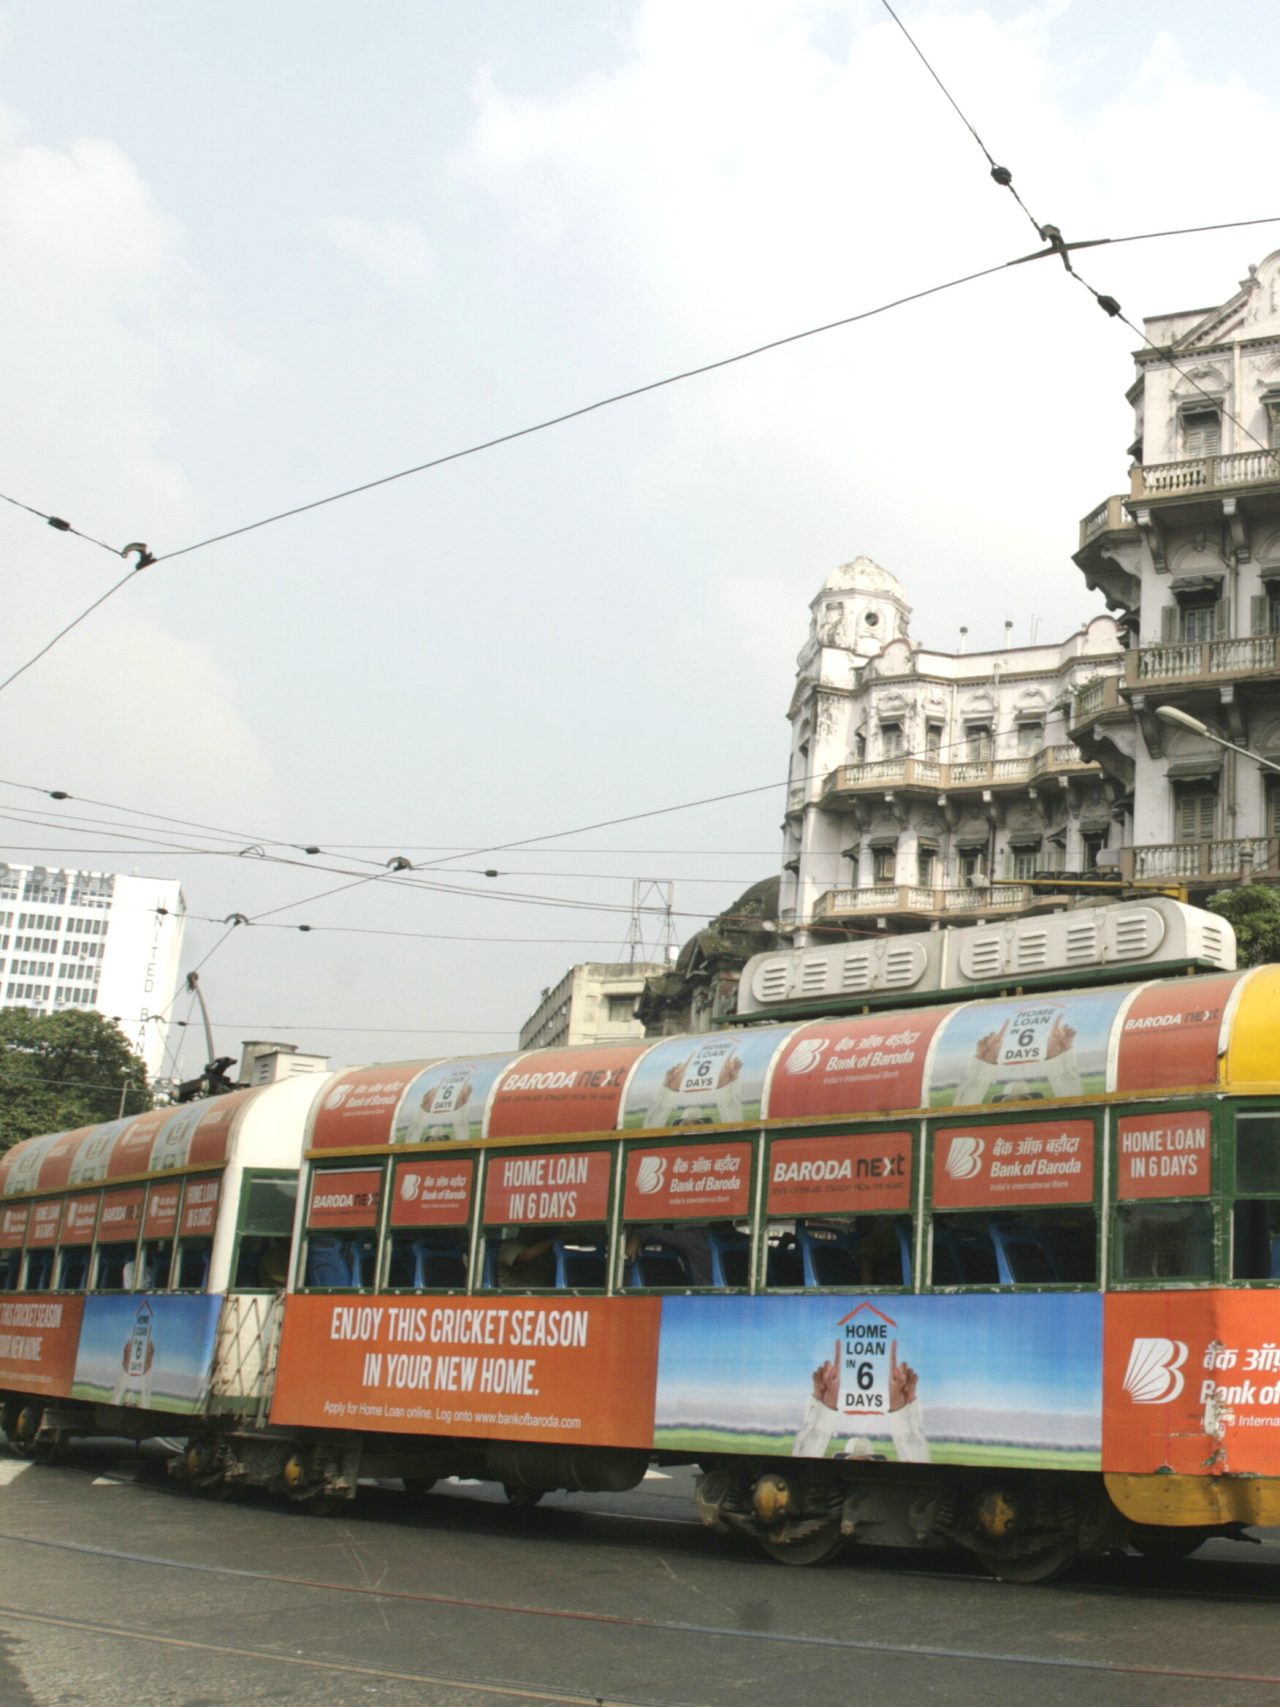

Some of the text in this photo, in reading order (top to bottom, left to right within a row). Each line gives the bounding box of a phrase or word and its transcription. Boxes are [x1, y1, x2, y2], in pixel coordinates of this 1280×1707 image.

[31, 865, 116, 890] BANK
[1013, 1016, 1051, 1027] LOAN
[1017, 1008, 1057, 1018] HOME
[1124, 1013, 1183, 1031] BARODA
[1018, 1028, 1035, 1047] 6
[825, 1049, 915, 1072] Bank of Baroda
[1005, 1047, 1040, 1060] DAYS
[697, 1060, 712, 1077] 6
[501, 1071, 578, 1091] BARODA
[685, 1077, 713, 1088] DAYS
[442, 1085, 454, 1100] 6
[1122, 1128, 1205, 1153] HOME LOAN
[503, 1157, 589, 1187] HOME LOAN
[773, 1159, 852, 1182] BARODA
[990, 1157, 1082, 1177] Bank of Baroda
[1130, 1154, 1198, 1178] IN 6 DAYS
[670, 1175, 740, 1192] Bank of Baroda
[313, 1194, 353, 1208] BARODA
[508, 1191, 577, 1220] IN 6 DAYS
[330, 1306, 589, 1347] ENJOY THIS CRICKET SEASON
[845, 1324, 888, 1339] HOME
[846, 1341, 886, 1355] LOAN
[362, 1353, 540, 1395] IN YOUR NEW HOME.
[846, 1359, 874, 1390] IN 6
[845, 1393, 883, 1407] DAYS
[1200, 1379, 1256, 1405] Bank
[323, 1400, 582, 1429] Apply for Home Loan online. Log onto www.bankofbaroda.com
